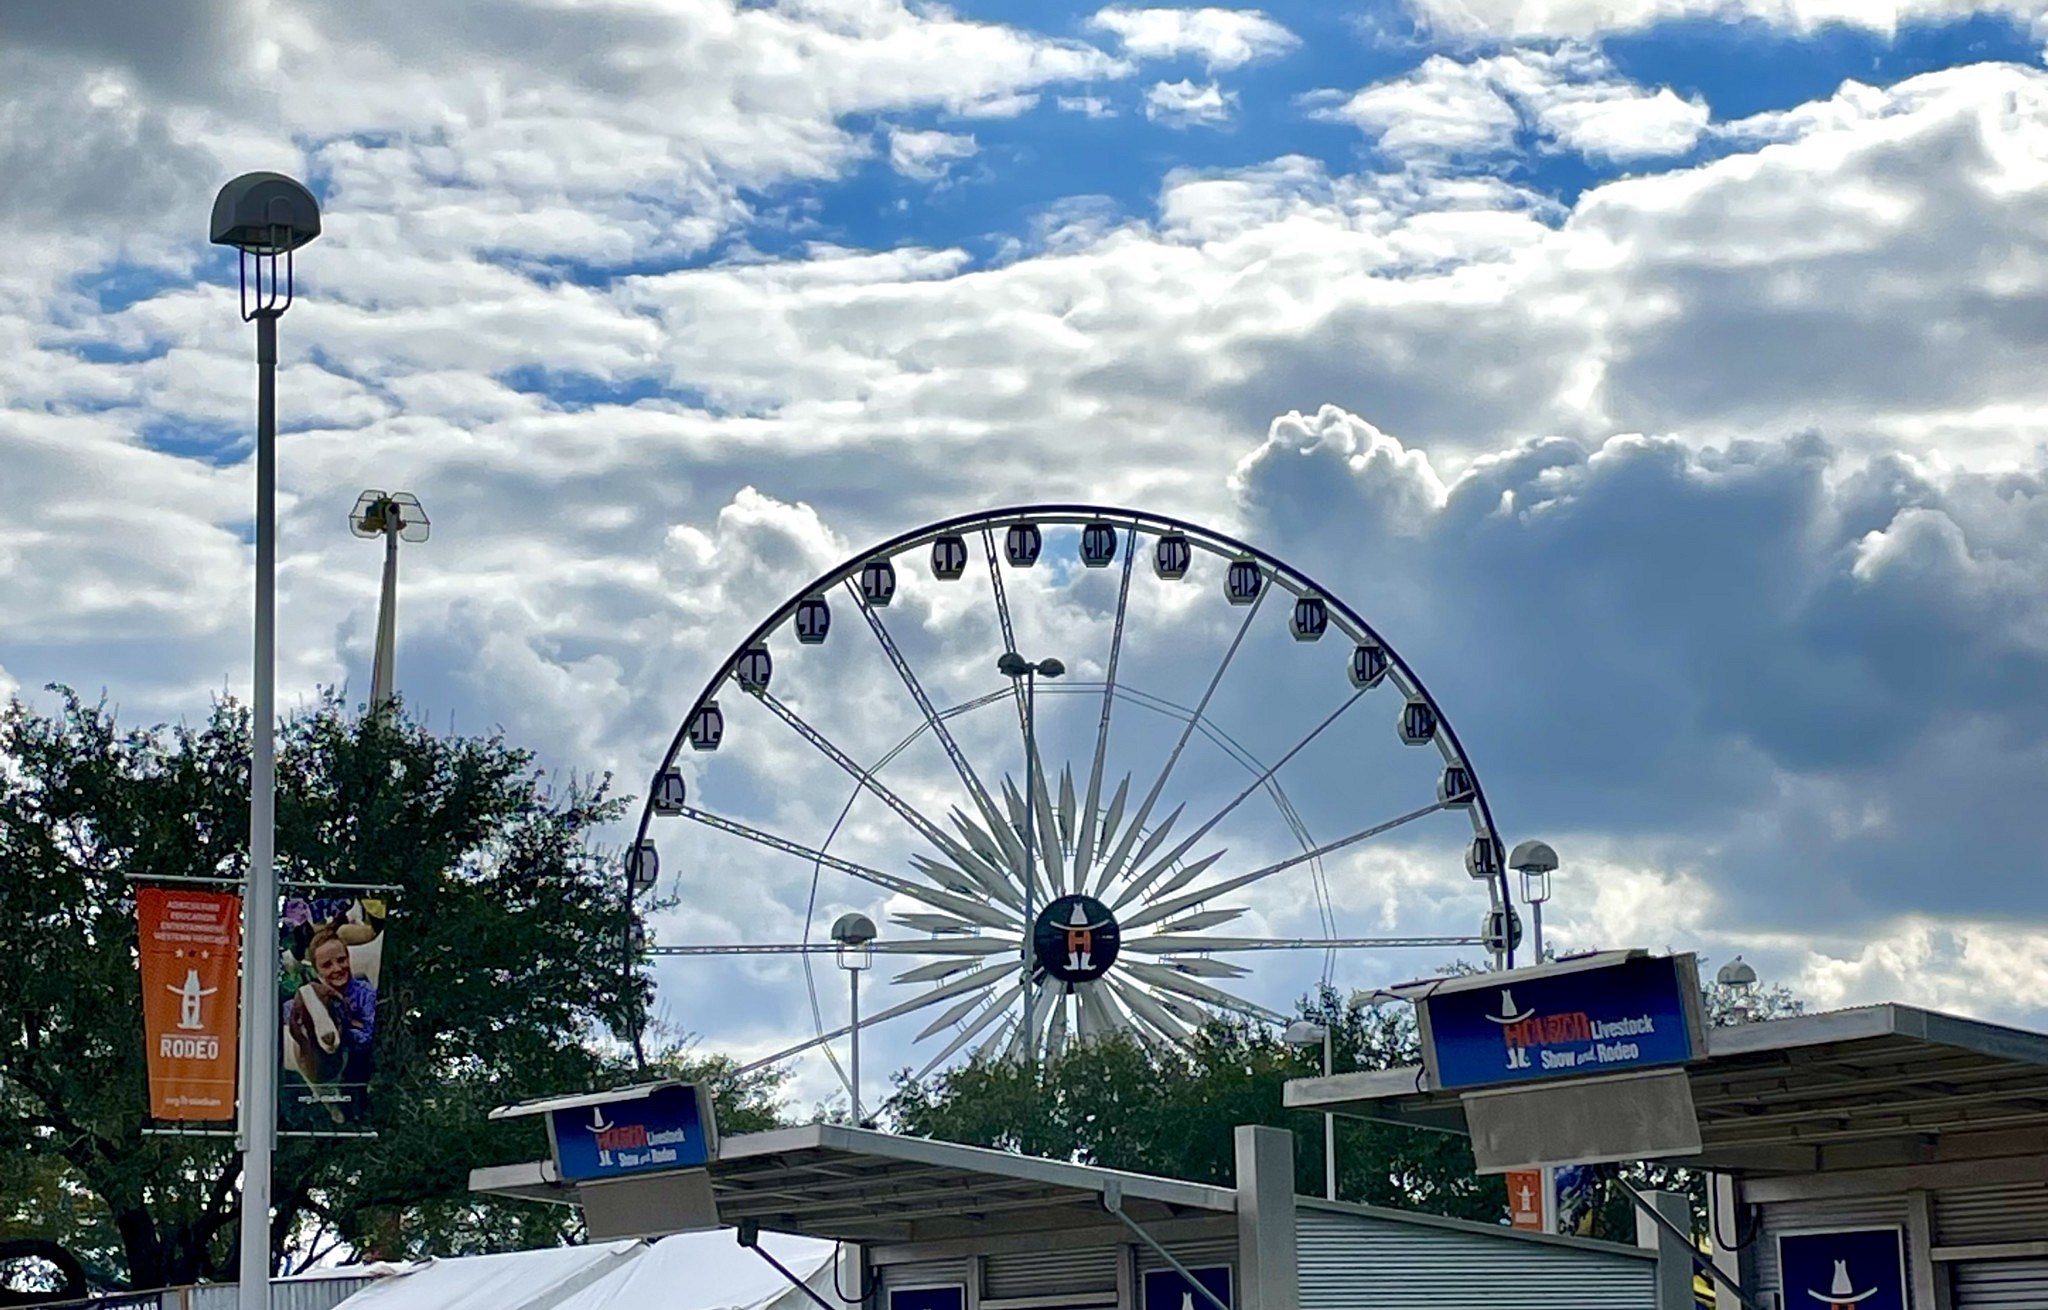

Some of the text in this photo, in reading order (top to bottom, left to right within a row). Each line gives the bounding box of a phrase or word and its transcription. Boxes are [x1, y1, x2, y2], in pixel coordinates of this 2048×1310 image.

[1590, 1014, 1655, 1041] Livestock
[160, 1039, 219, 1060] RODEO
[1540, 1041, 1639, 1070] Show and Rodeo
